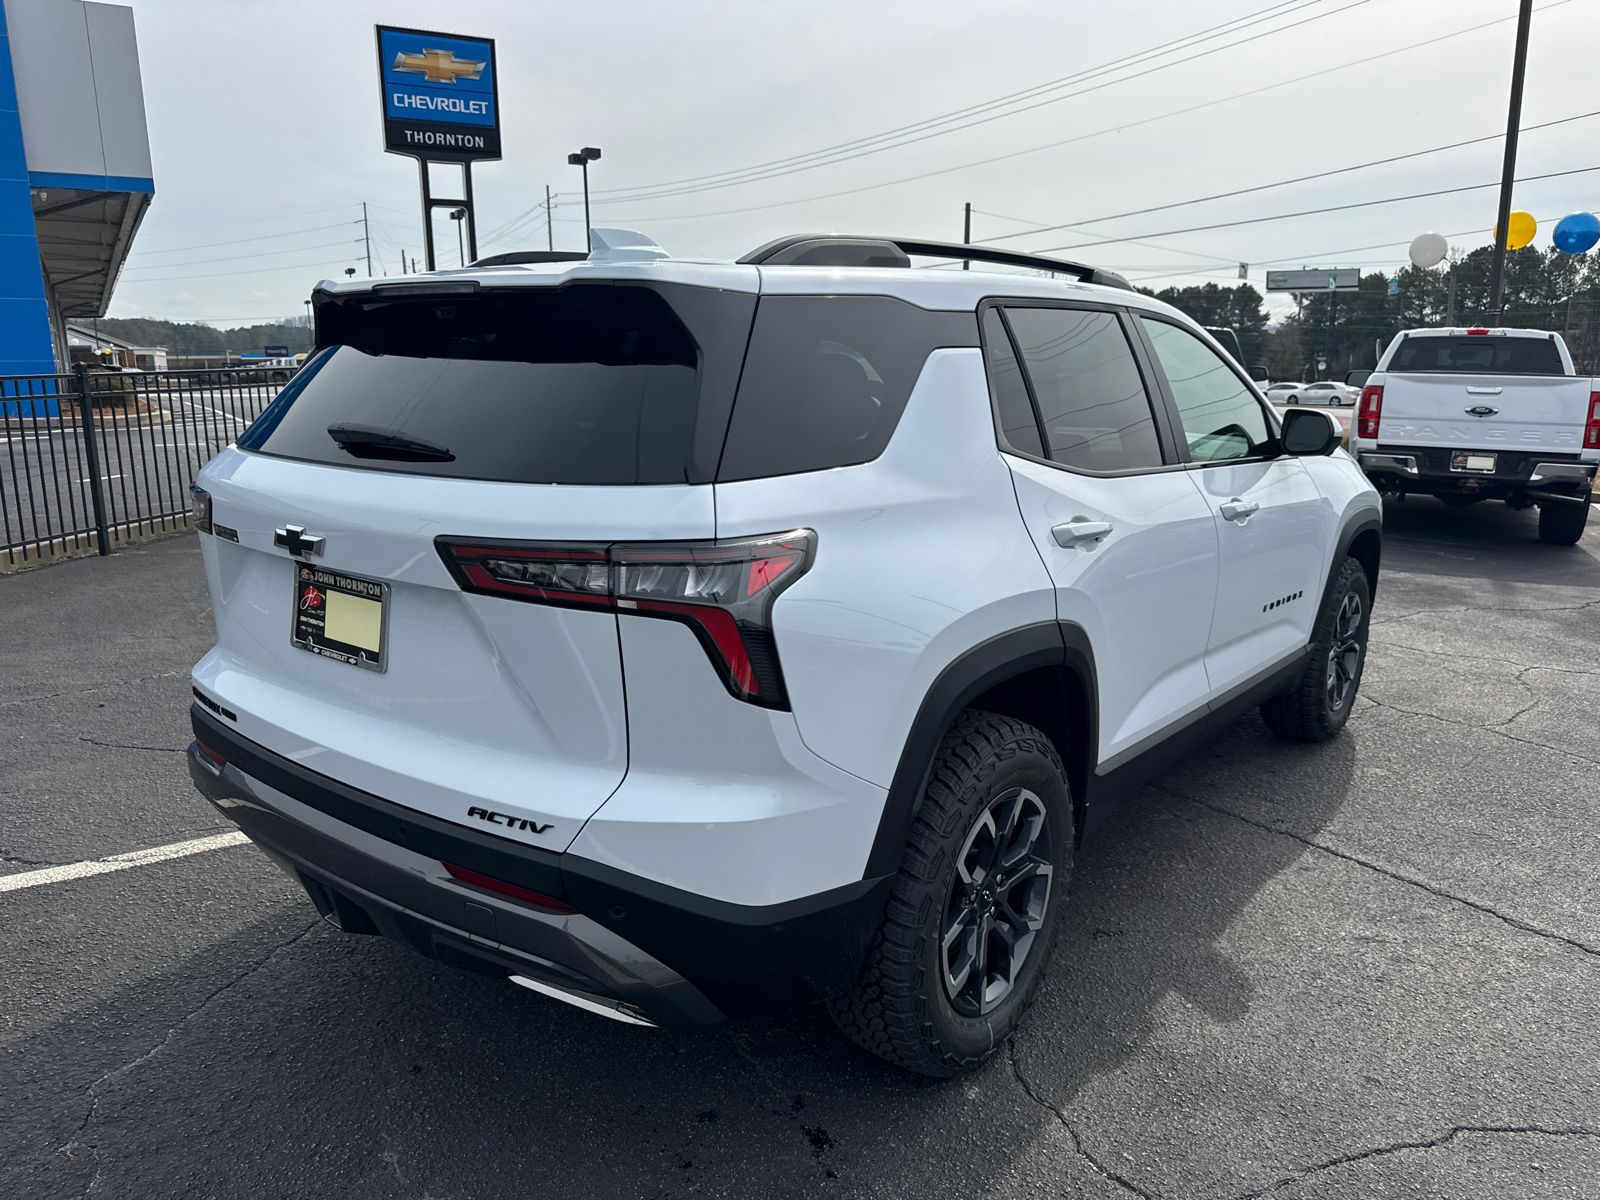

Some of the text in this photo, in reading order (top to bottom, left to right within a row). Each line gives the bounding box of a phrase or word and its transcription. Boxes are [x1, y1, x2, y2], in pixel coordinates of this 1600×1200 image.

[393, 93, 489, 115] CHEVROLET
[404, 130, 484, 148] THORNTON
[1384, 424, 1578, 444] RANGER
[315, 571, 381, 596] JOHN THORNTON
[321, 650, 348, 662] CHEVROLET
[467, 806, 555, 834] ACTIV
